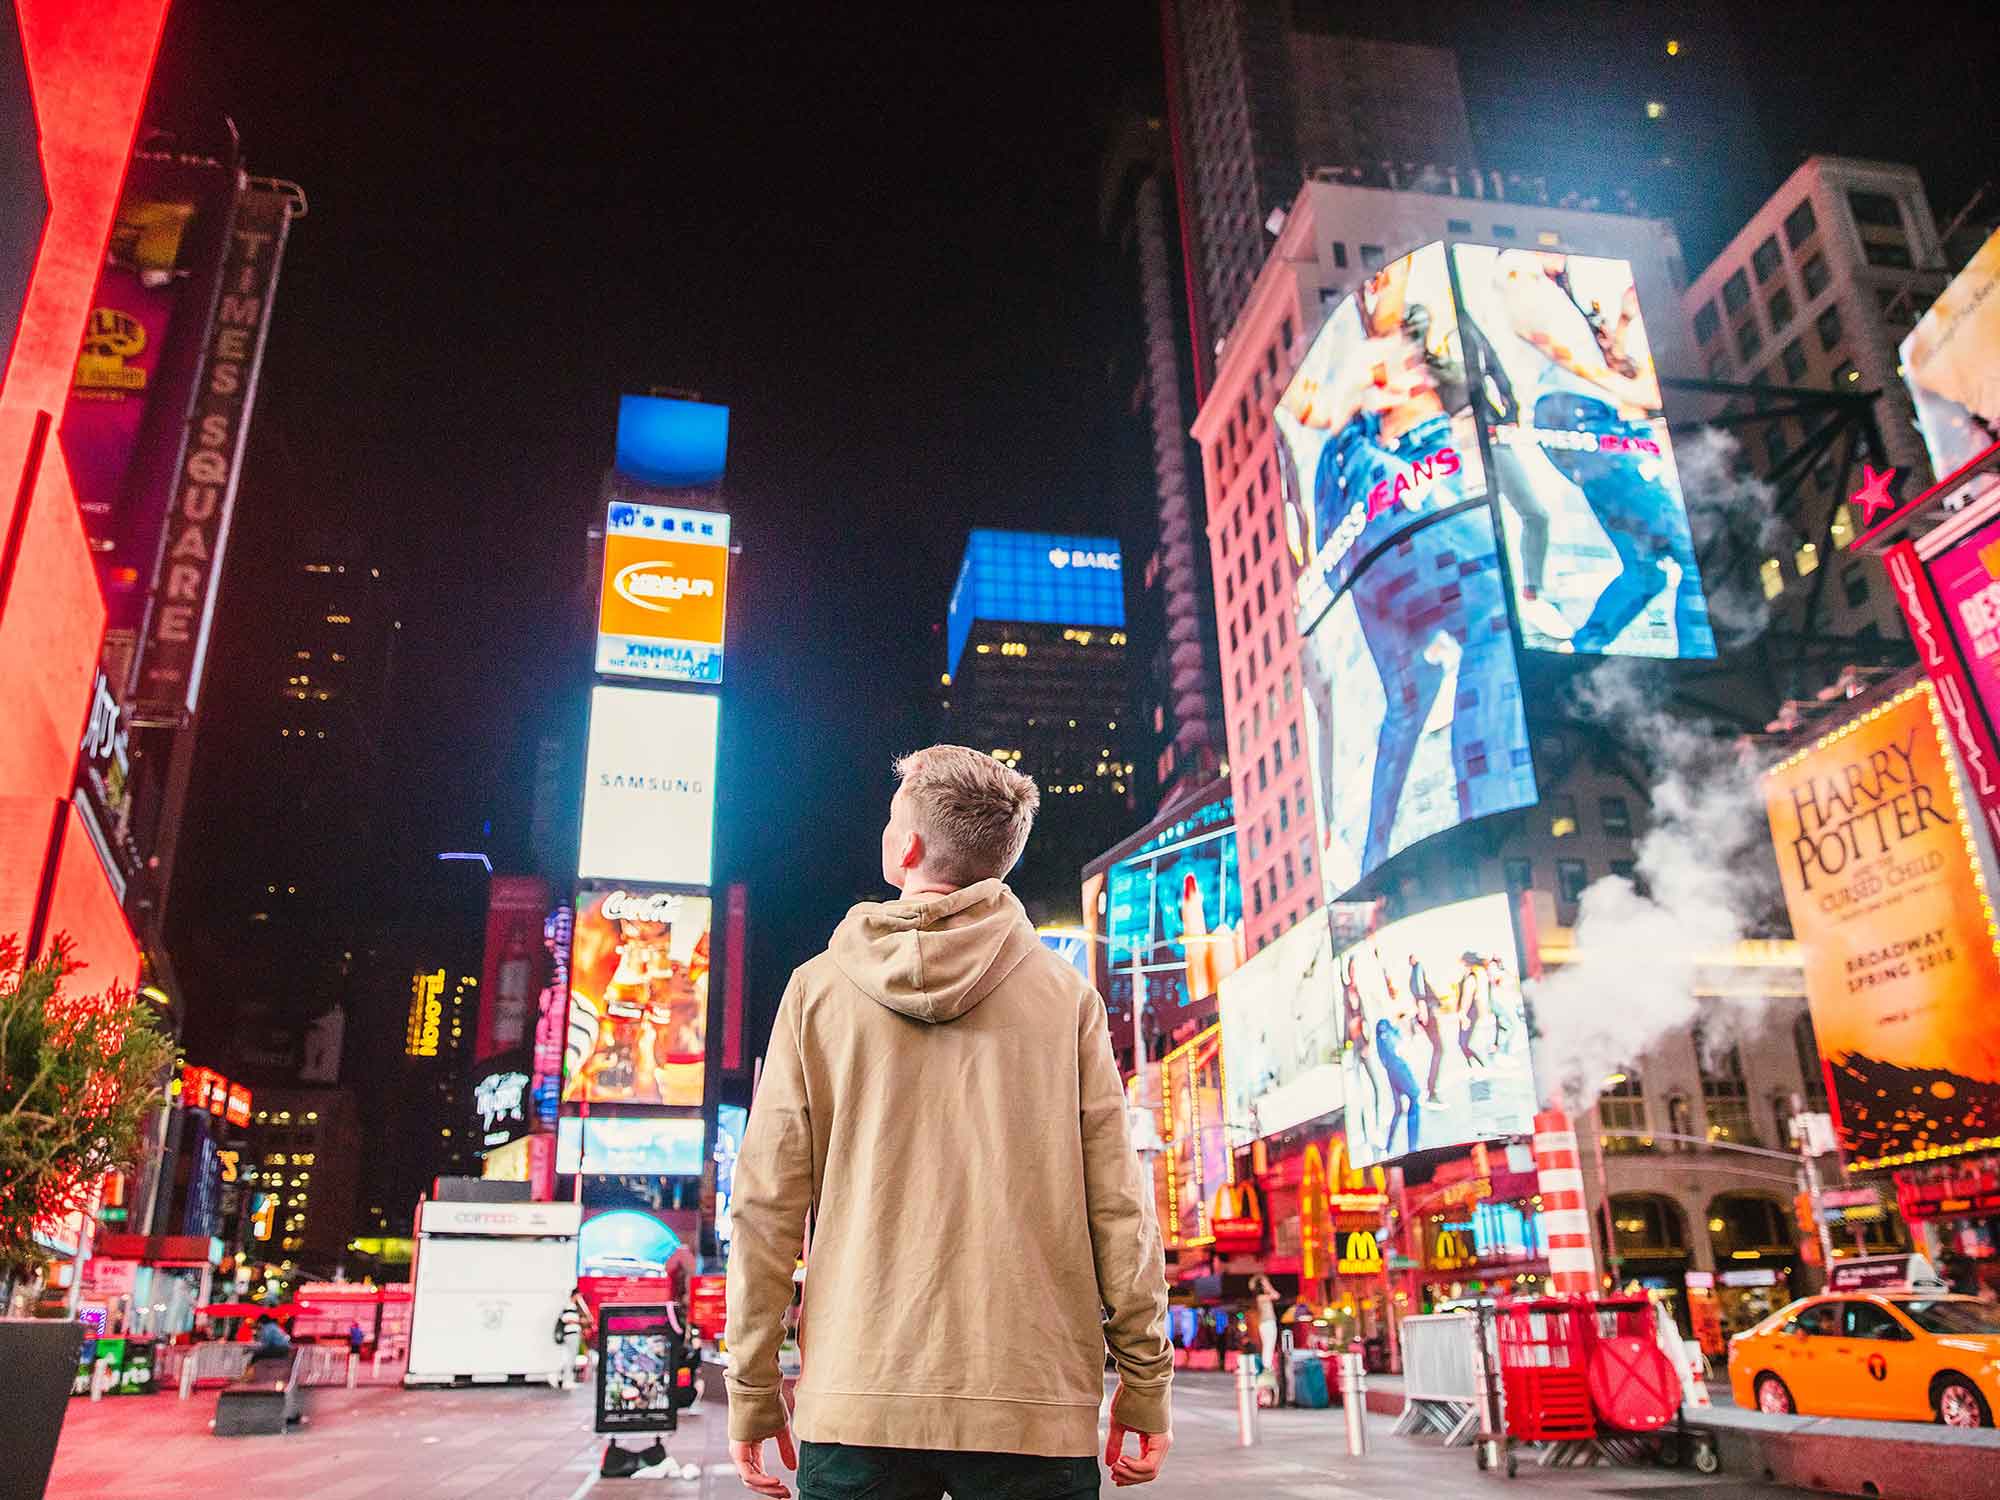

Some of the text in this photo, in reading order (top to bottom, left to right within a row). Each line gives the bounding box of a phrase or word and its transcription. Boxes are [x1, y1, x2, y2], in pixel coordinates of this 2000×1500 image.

[158, 231, 272, 641] TIMES SQUARE
[1367, 447, 1460, 521] JEANS
[600, 773, 703, 793] SAMSUNG
[1792, 728, 1918, 836] HARRY
[1792, 785, 1951, 890] POTTER
[1845, 928, 1944, 974] BROADWAY
